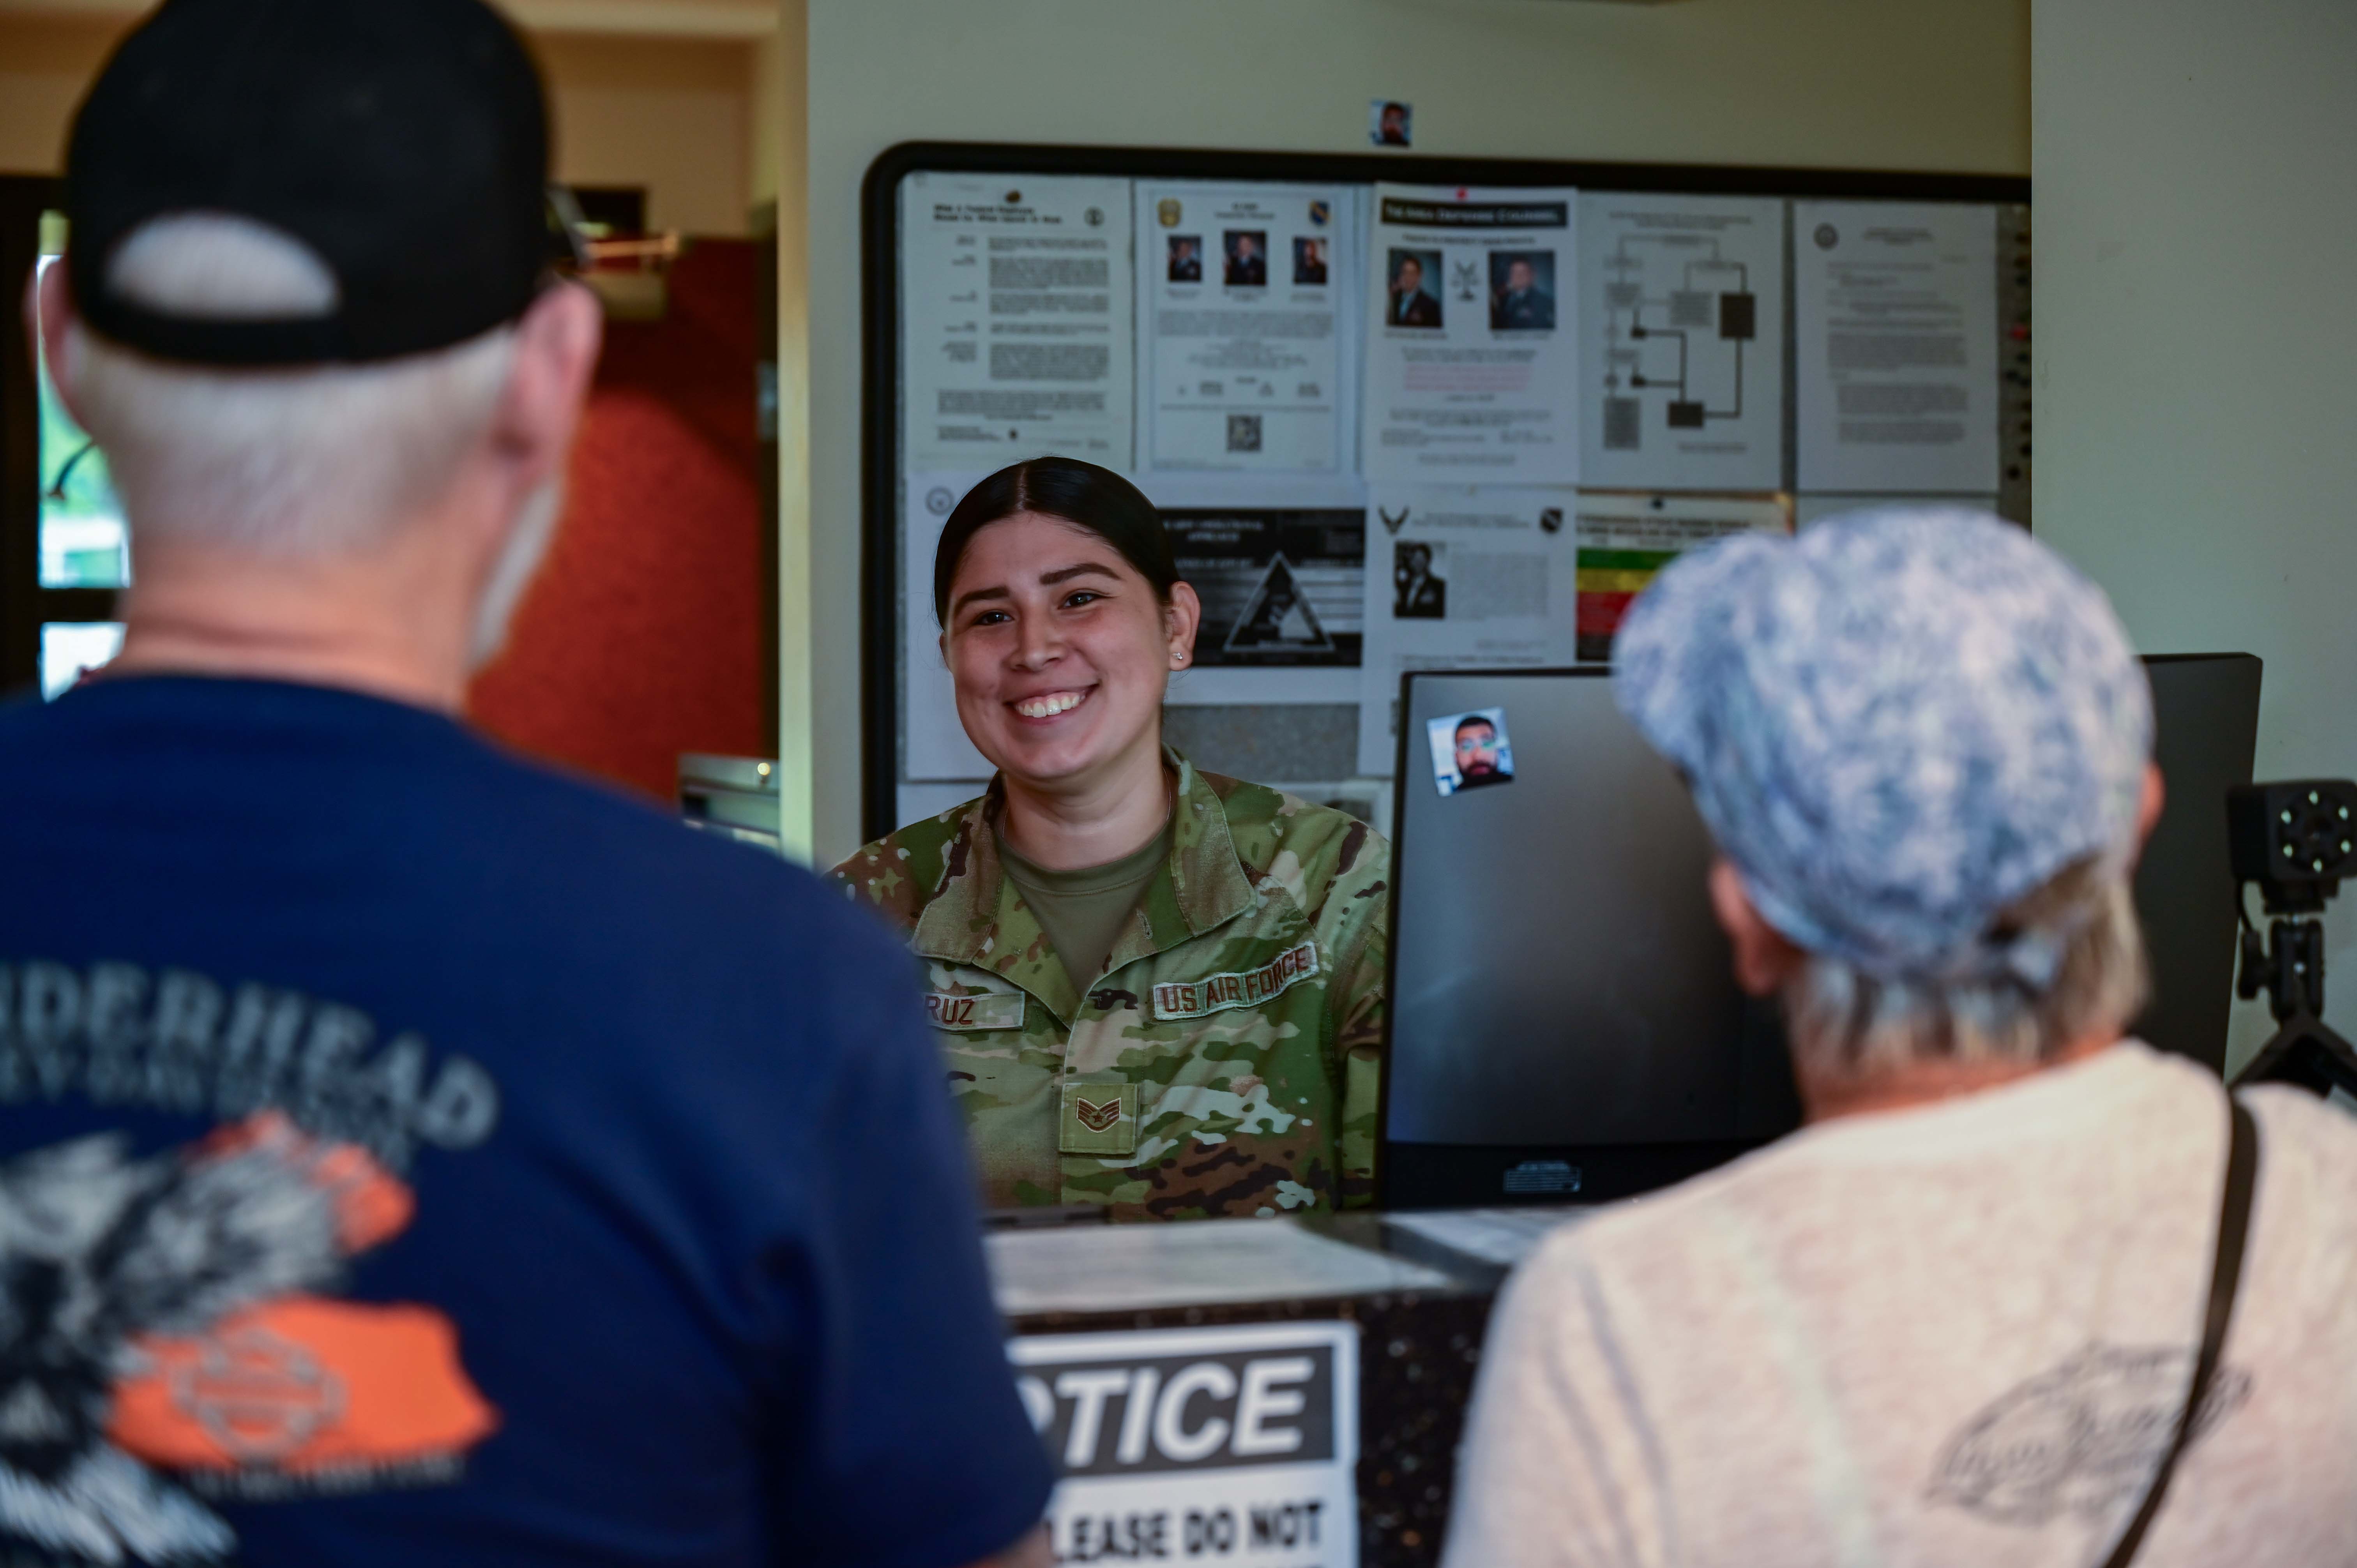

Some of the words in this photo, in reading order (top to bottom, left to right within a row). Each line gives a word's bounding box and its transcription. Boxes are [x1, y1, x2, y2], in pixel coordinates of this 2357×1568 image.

[1162, 987, 1201, 1013] U.S.
[1206, 976, 1242, 1008] AIR
[1246, 945, 1309, 1000] FORCE
[0, 959, 501, 1150] DERHEAD
[1185, 1506, 1235, 1556] DO
[1248, 1499, 1323, 1549] NOT
